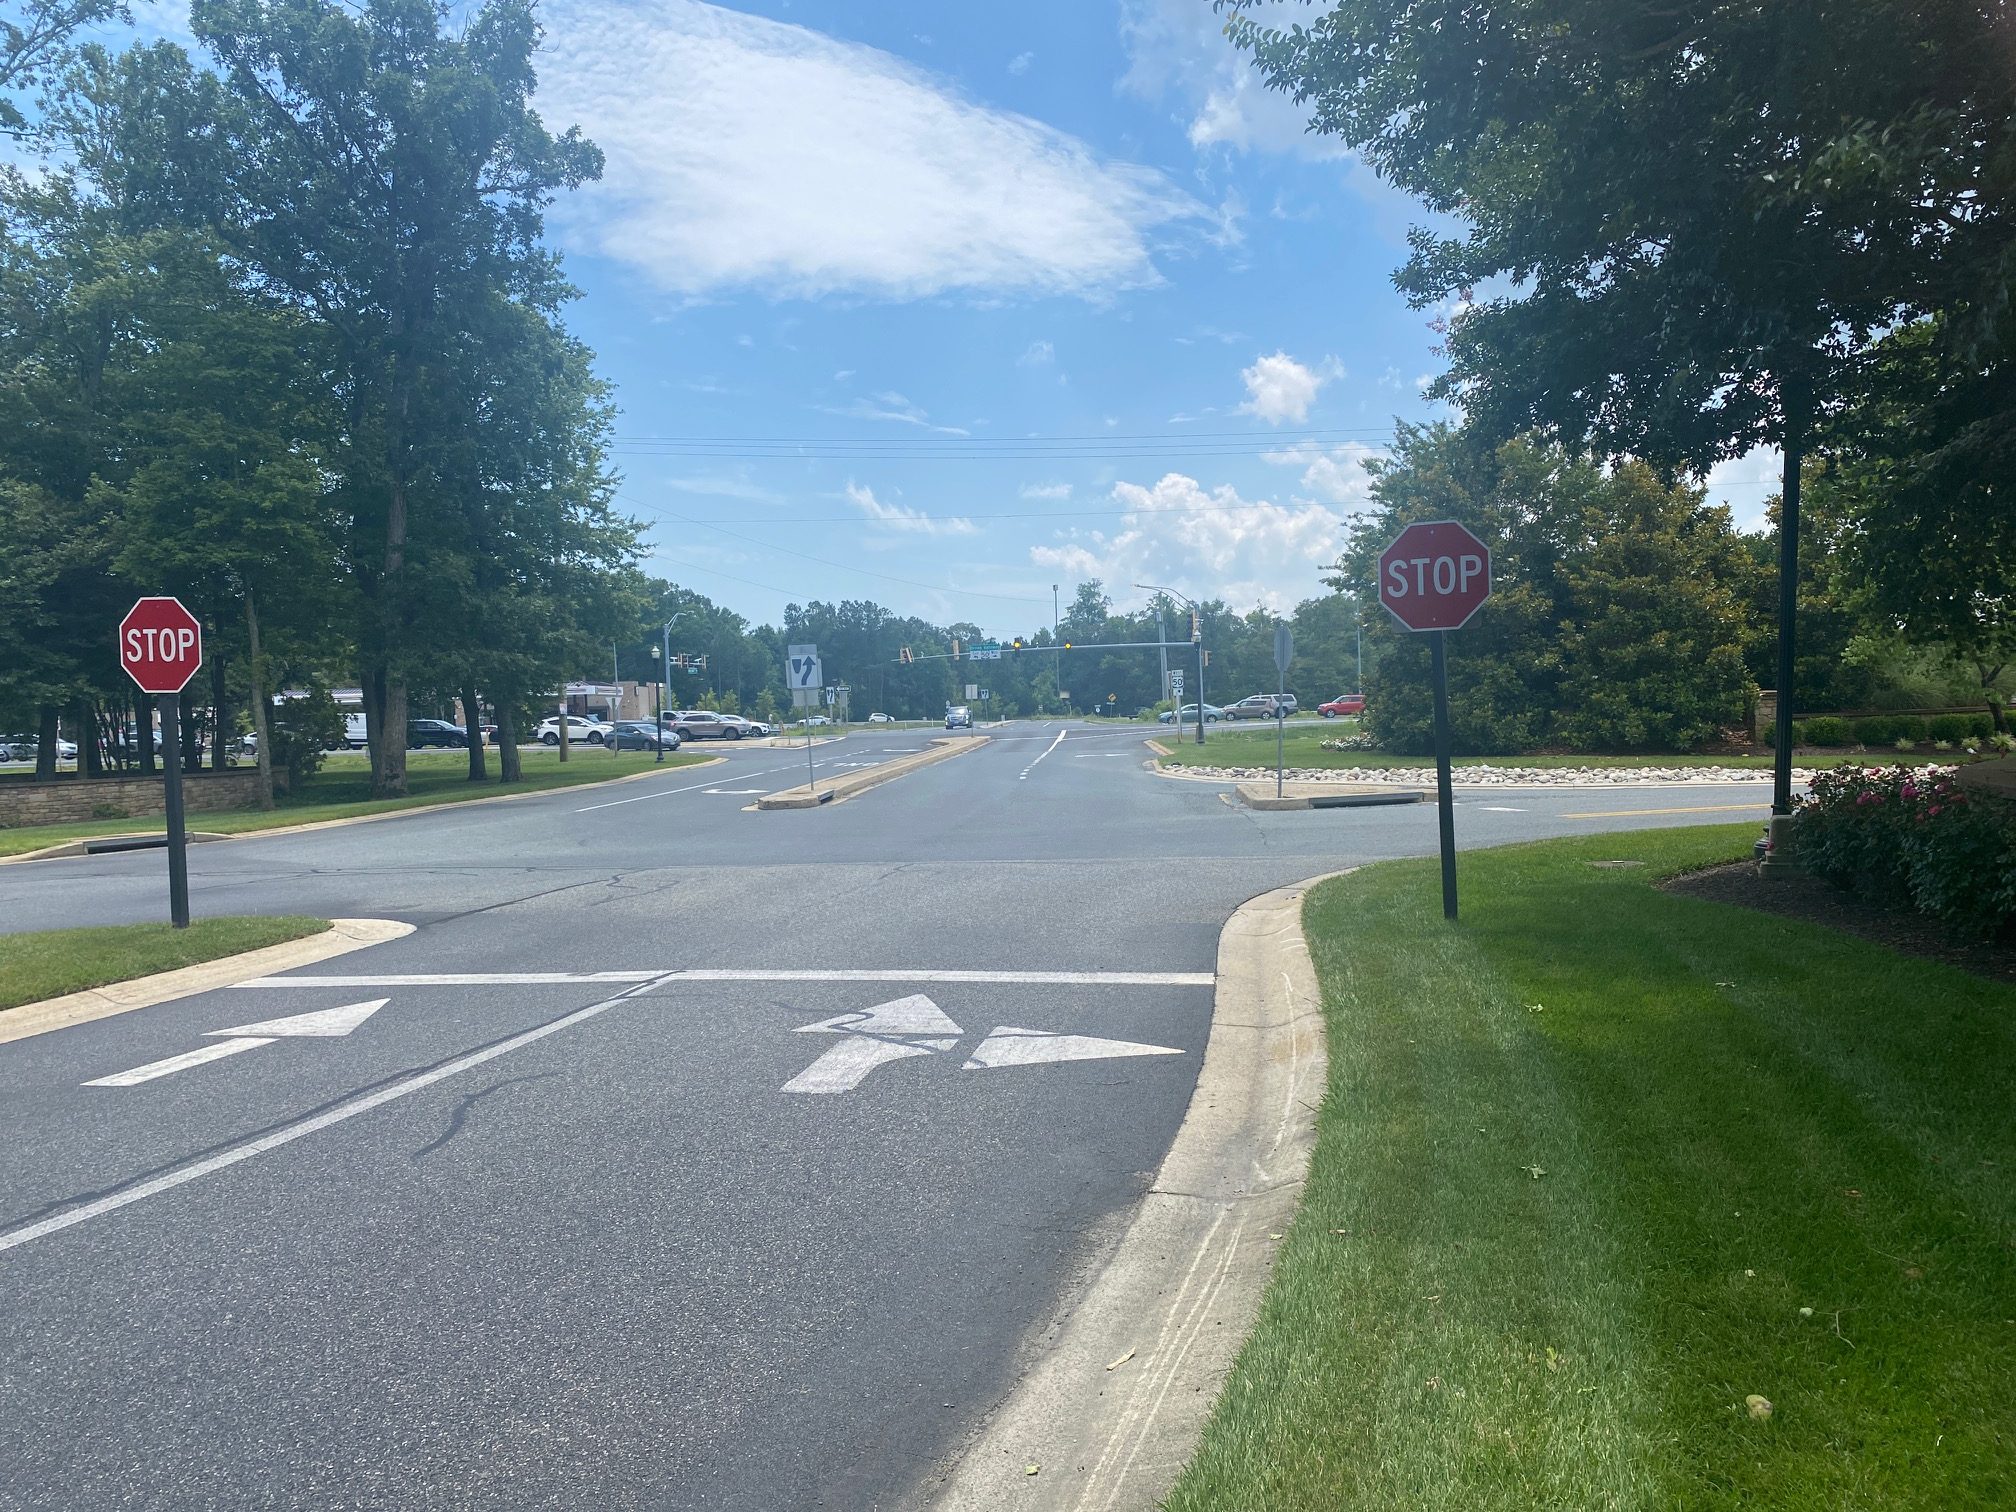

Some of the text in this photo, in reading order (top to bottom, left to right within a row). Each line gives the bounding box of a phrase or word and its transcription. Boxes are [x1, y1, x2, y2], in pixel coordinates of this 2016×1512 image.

[1387, 555, 1482, 598] STOP
[126, 628, 195, 662] STOP
[1173, 678, 1183, 686] 50
